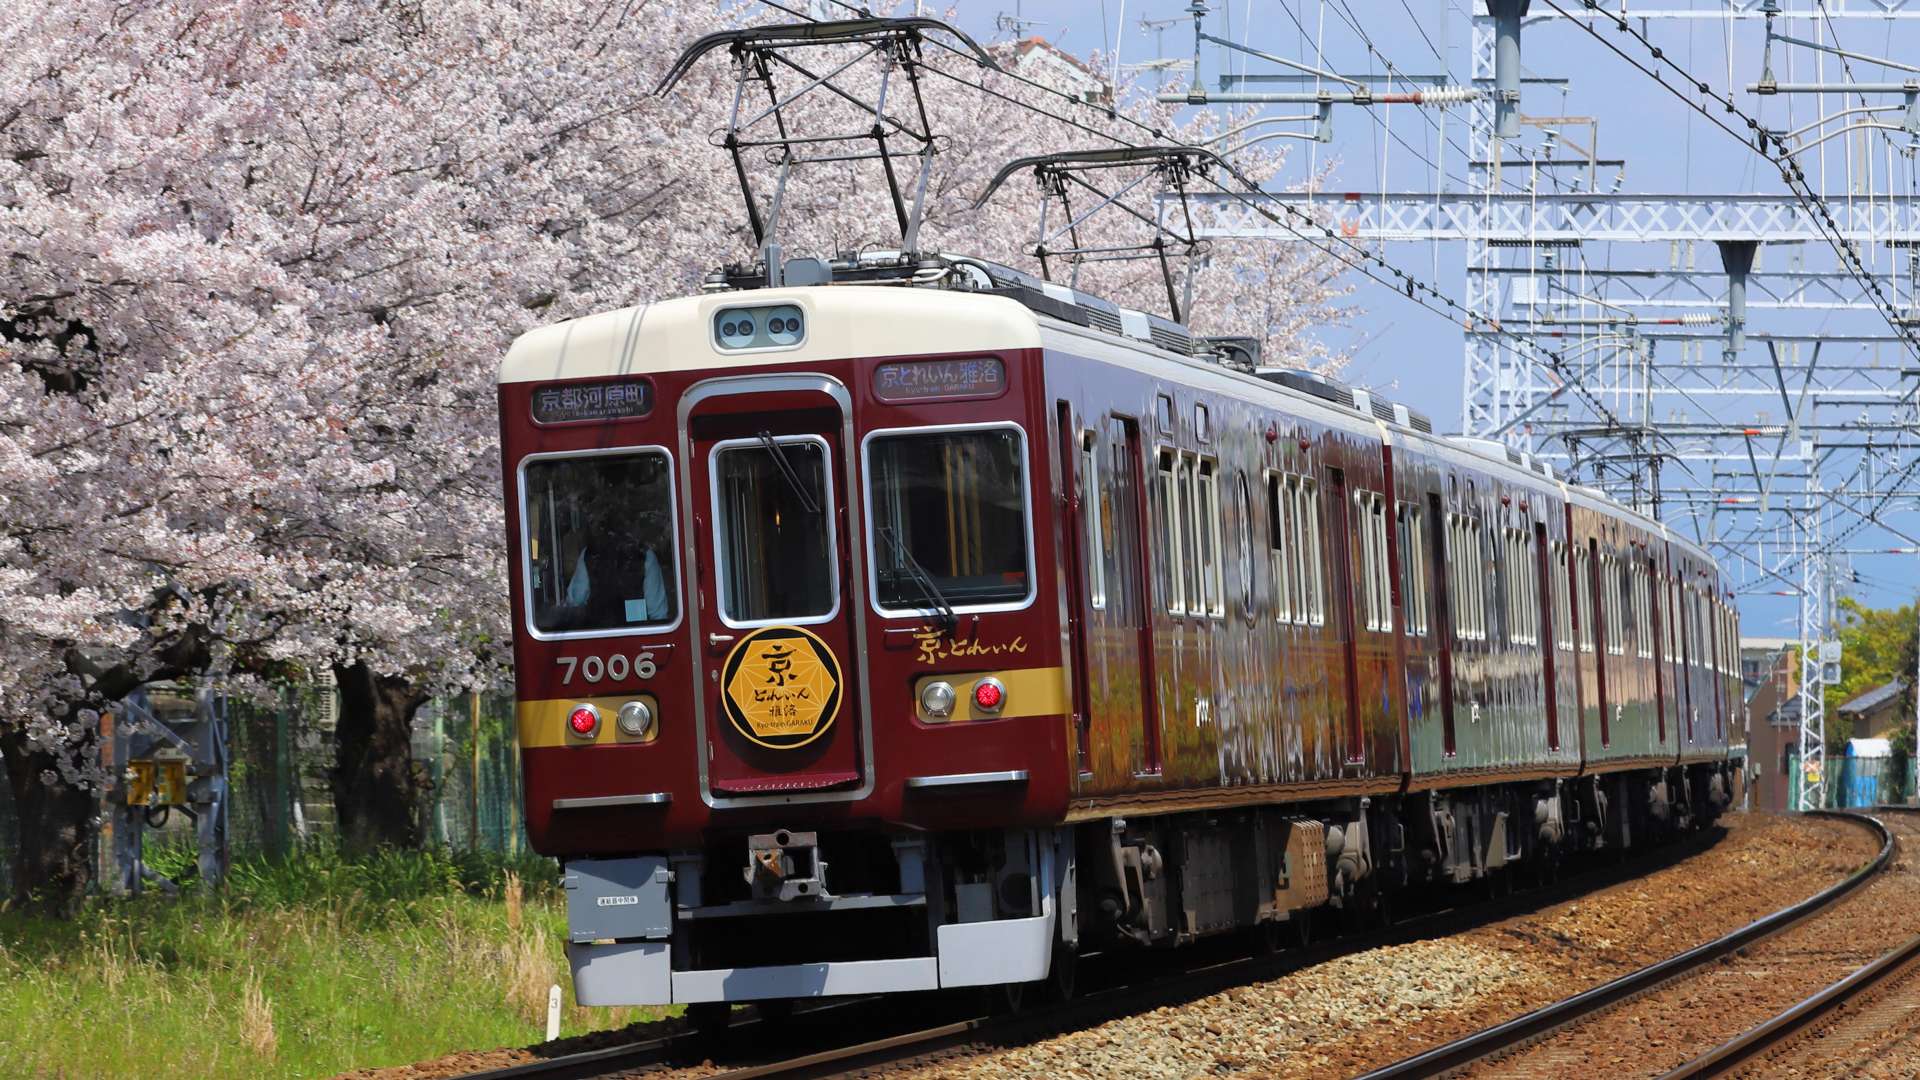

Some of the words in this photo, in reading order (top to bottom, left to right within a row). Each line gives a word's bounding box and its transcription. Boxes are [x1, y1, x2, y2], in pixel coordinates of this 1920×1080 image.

[541, 384, 644, 412] 京都河原町
[913, 625, 1028, 665] 京とれいん
[556, 651, 657, 685] 7006
[761, 645, 798, 687] 京
[754, 688, 810, 703] とれいん
[551, 998, 558, 1009] 3
